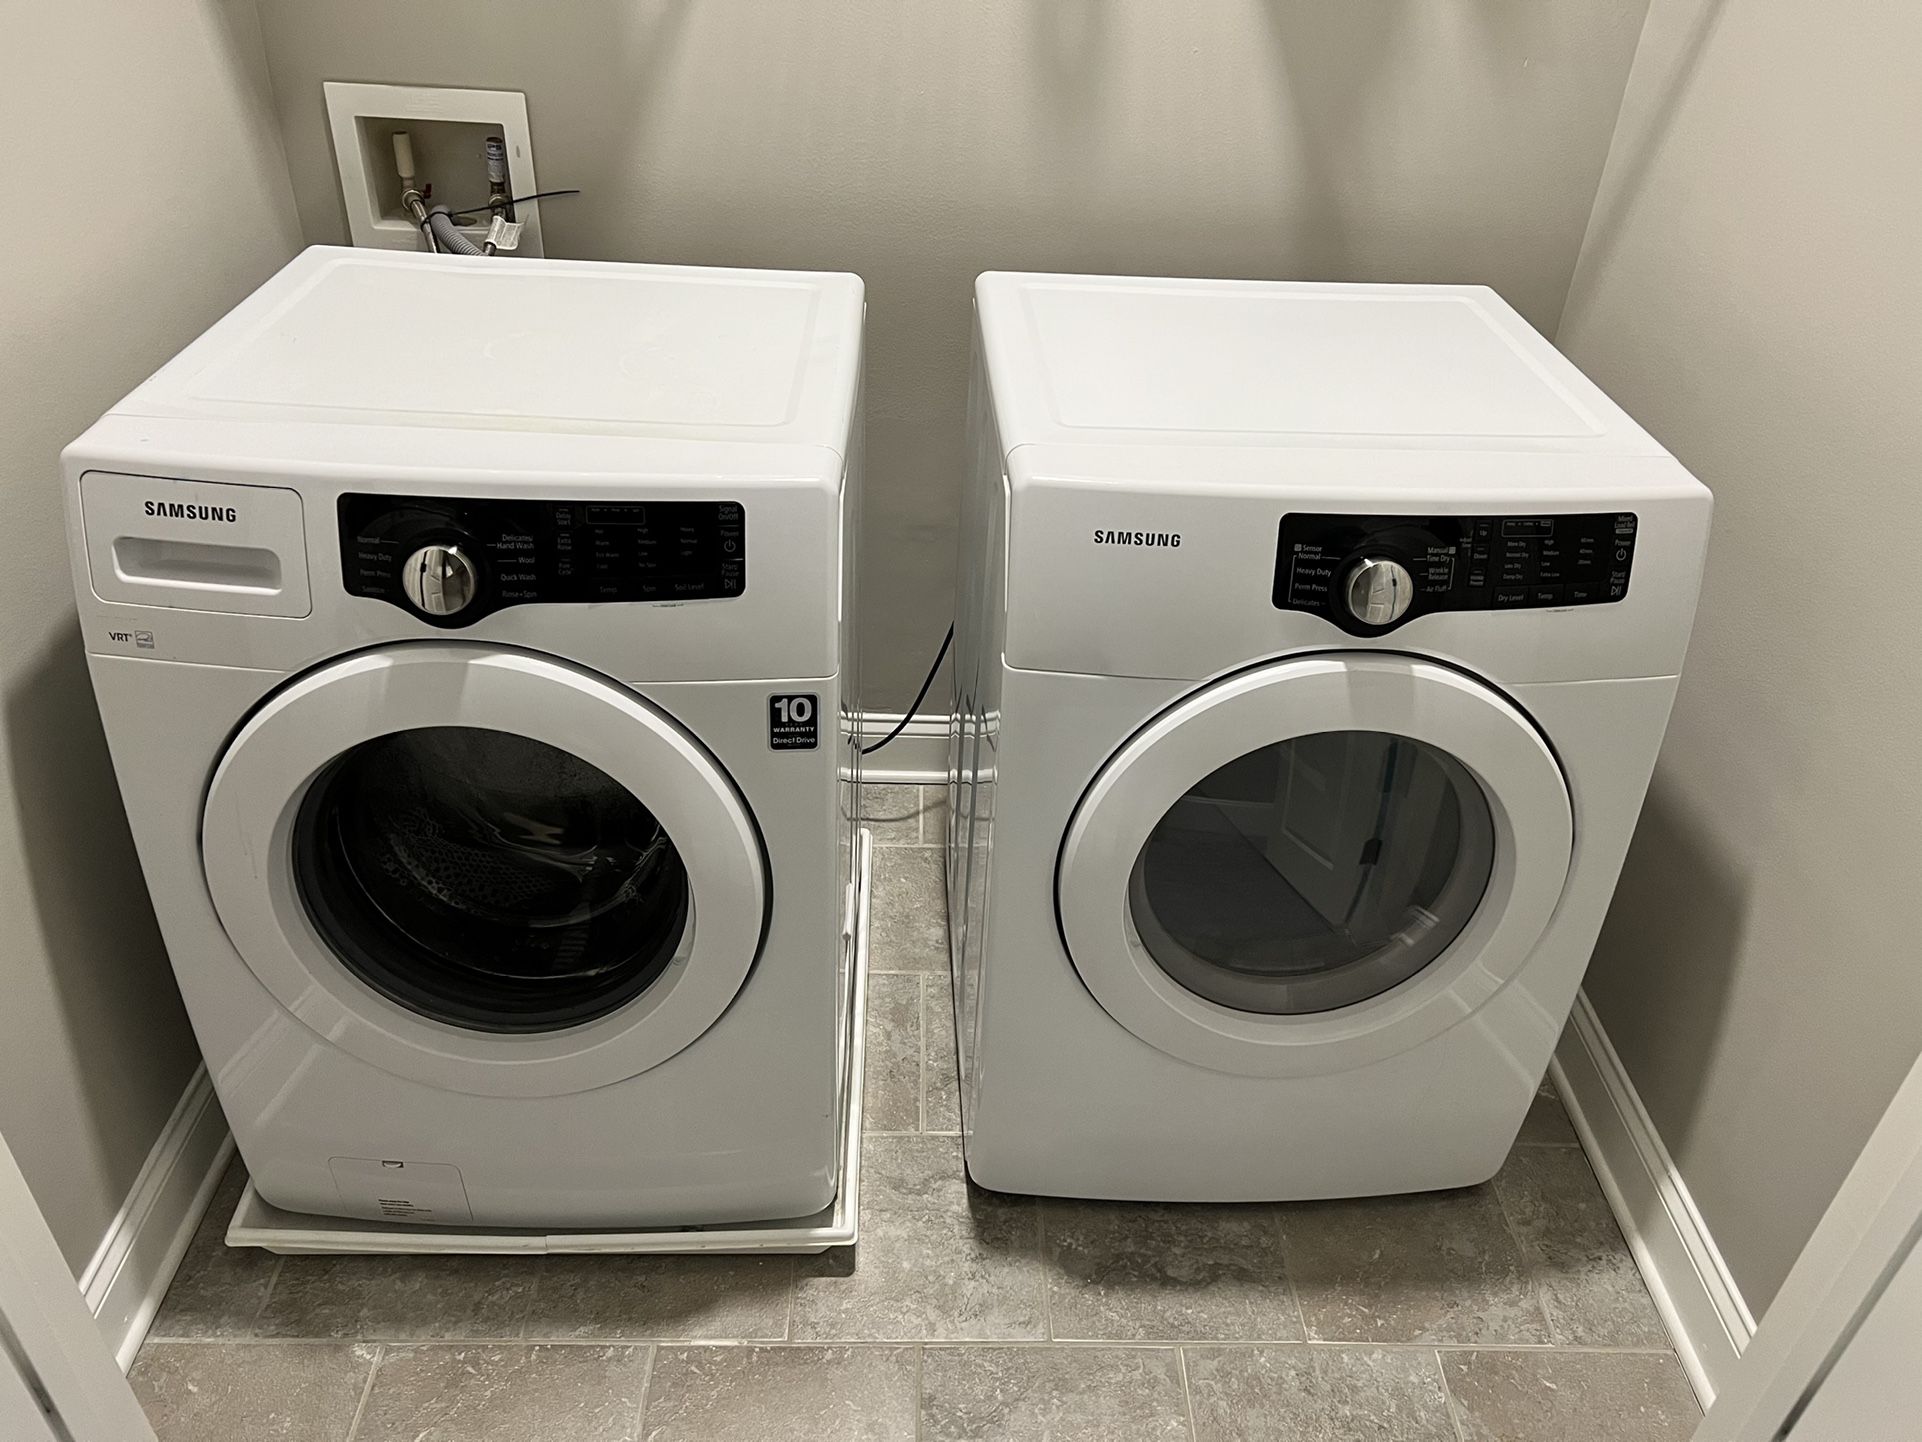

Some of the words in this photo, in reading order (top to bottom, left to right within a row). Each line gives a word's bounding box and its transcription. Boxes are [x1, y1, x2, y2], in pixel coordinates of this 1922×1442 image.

[144, 501, 237, 523] SAMSUNG
[719, 505, 738, 513] Signal
[1093, 529, 1182, 548] SAMSUNG
[358, 552, 377, 561] Heavy
[378, 552, 392, 562] Duty
[1440, 555, 1450, 563] Dry
[501, 573, 517, 581] Quick
[1296, 567, 1315, 576] Heavy
[1316, 568, 1332, 578] Duty
[1312, 584, 1327, 592] Press
[1292, 598, 1320, 606] Delicates
[1498, 594, 1508, 603] Dry
[774, 697, 813, 723] 10
